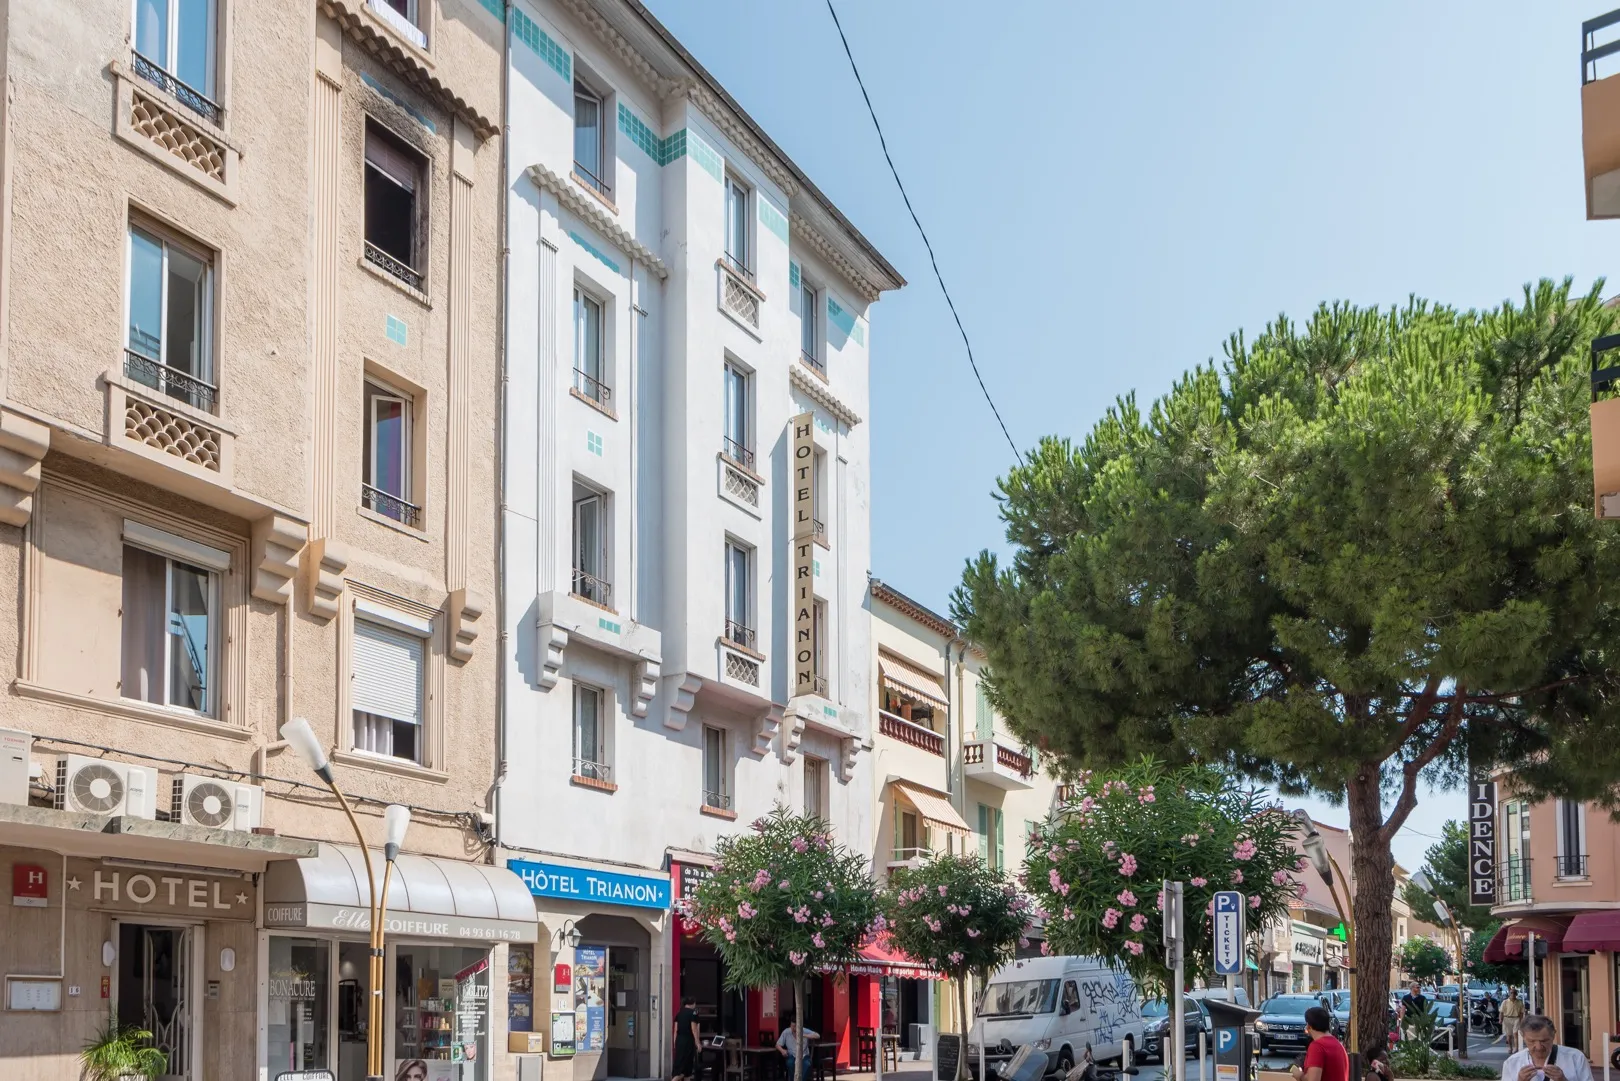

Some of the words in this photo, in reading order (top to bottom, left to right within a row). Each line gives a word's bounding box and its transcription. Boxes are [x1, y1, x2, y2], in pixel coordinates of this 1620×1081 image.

[796, 423, 811, 523] HOTEL
[797, 543, 811, 685] TRIANON
[28, 871, 44, 884] H
[93, 870, 231, 910] HOTEL
[522, 868, 580, 894] HÔTEL
[586, 876, 657, 903] TRIANON
[267, 906, 303, 922] COIFFURE
[1217, 895, 1231, 911] P
[332, 909, 371, 929] Elle
[384, 918, 449, 935] COIFFURE
[459, 926, 471, 937] 04
[472, 927, 484, 938] 93
[485, 928, 495, 938] 61
[498, 929, 509, 939] 16
[510, 930, 521, 940] 78
[1223, 915, 1231, 965] TICKETS
[269, 979, 316, 997] BONACURE
[1219, 1030, 1232, 1049] P
